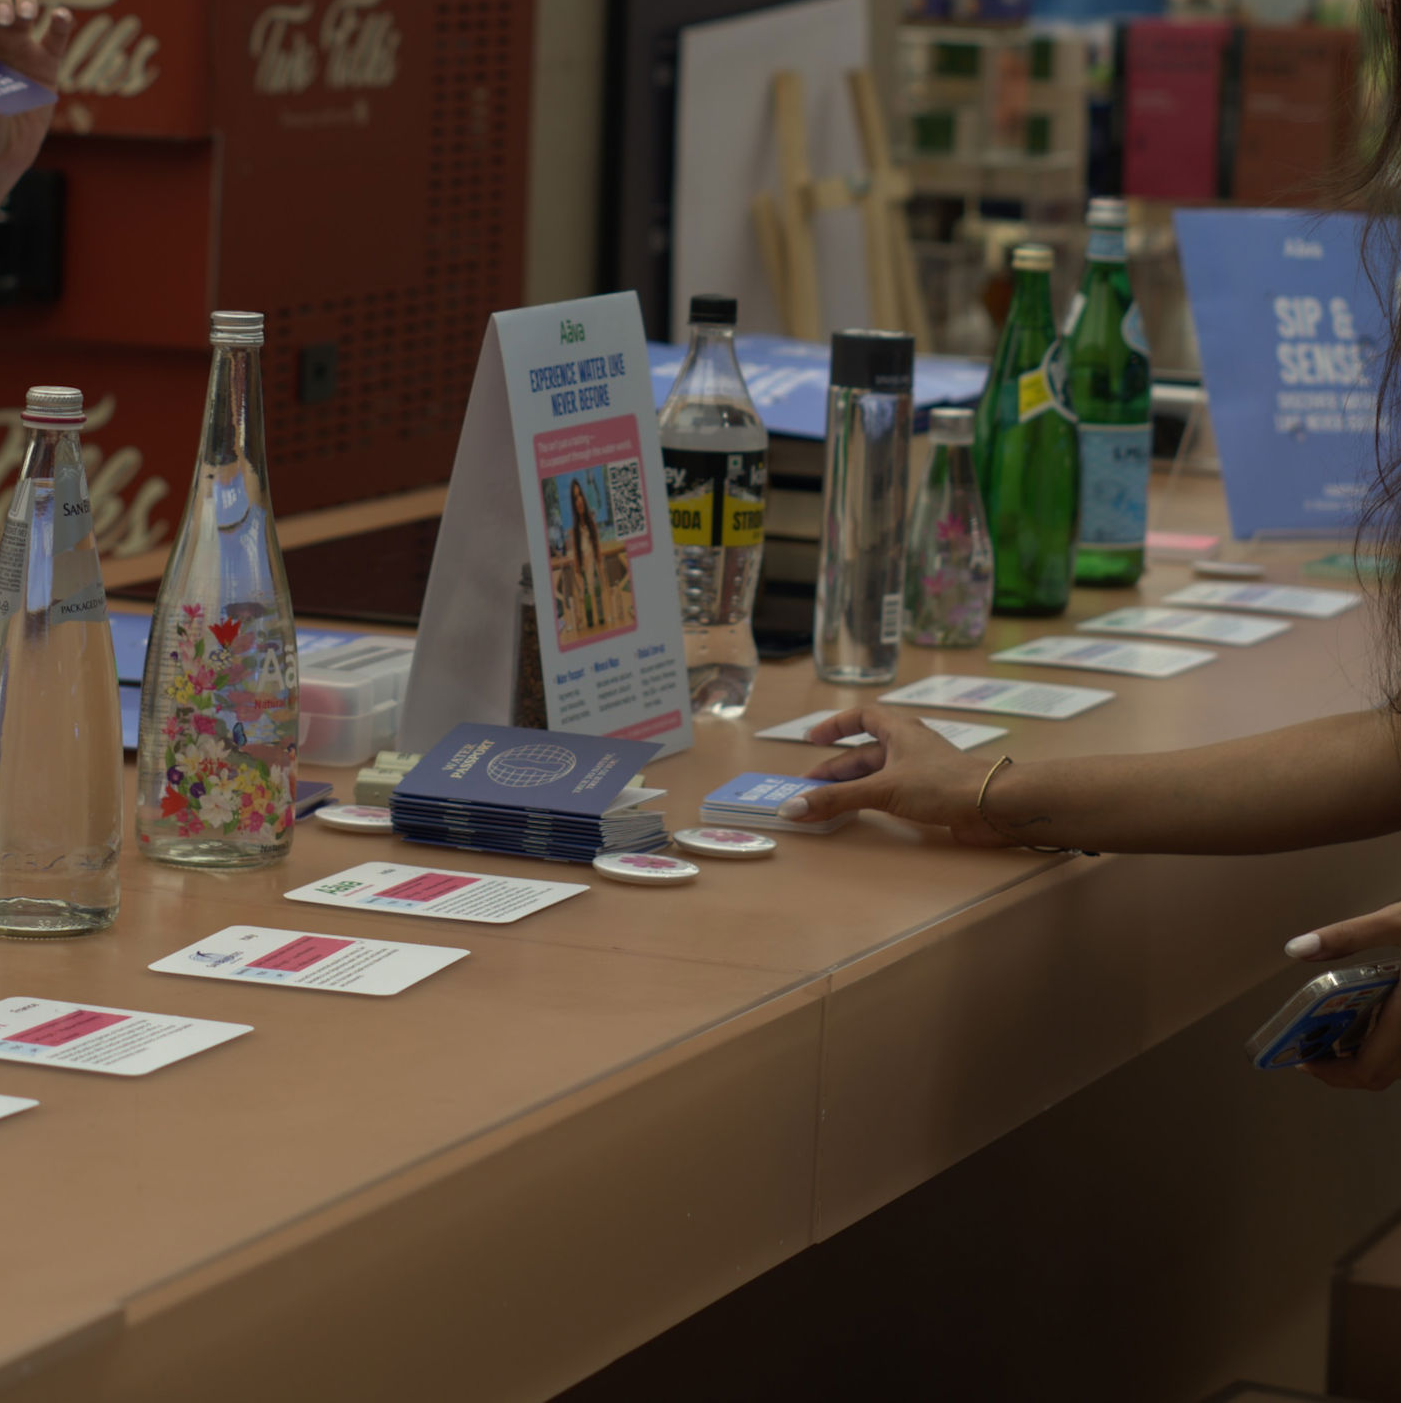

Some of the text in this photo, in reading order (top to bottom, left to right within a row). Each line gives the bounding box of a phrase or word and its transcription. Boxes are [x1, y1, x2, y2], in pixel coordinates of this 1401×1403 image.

[1274, 296, 1322, 339] SIP
[529, 352, 626, 393] EXPERIENCE WATER LIKE
[550, 383, 611, 417] NEVER BEFORE
[441, 742, 479, 772] WATER
[449, 738, 496, 780] PASSPORT
